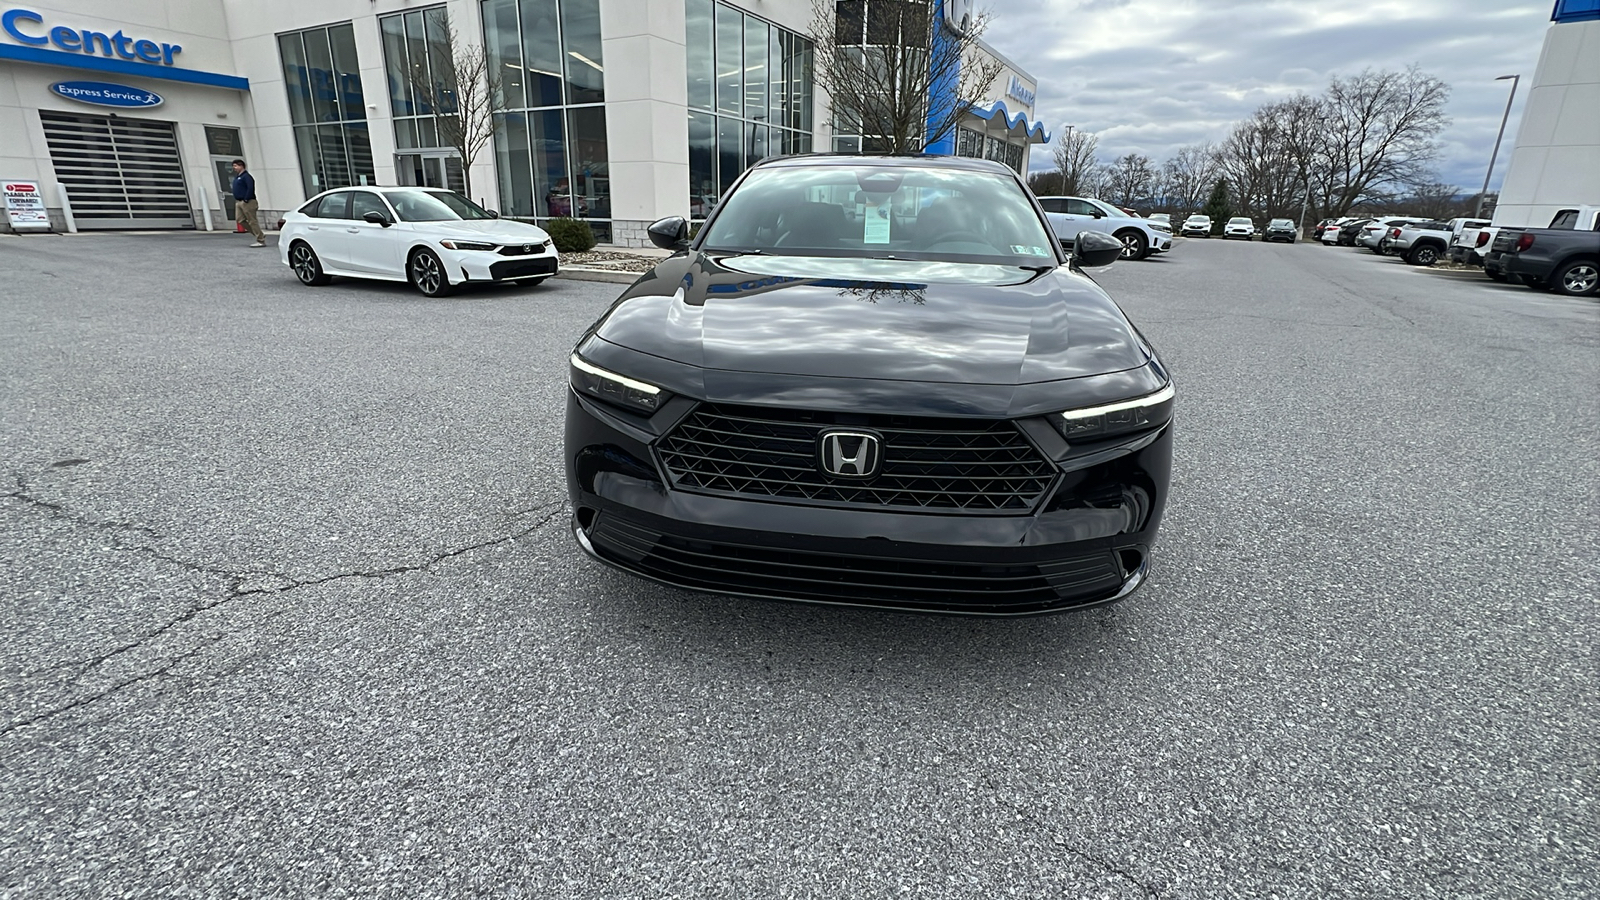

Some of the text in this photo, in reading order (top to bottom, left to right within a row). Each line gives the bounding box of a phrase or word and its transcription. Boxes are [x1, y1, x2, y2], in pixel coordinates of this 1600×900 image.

[1, 8, 182, 66] Center
[58, 84, 142, 101] Express Service
